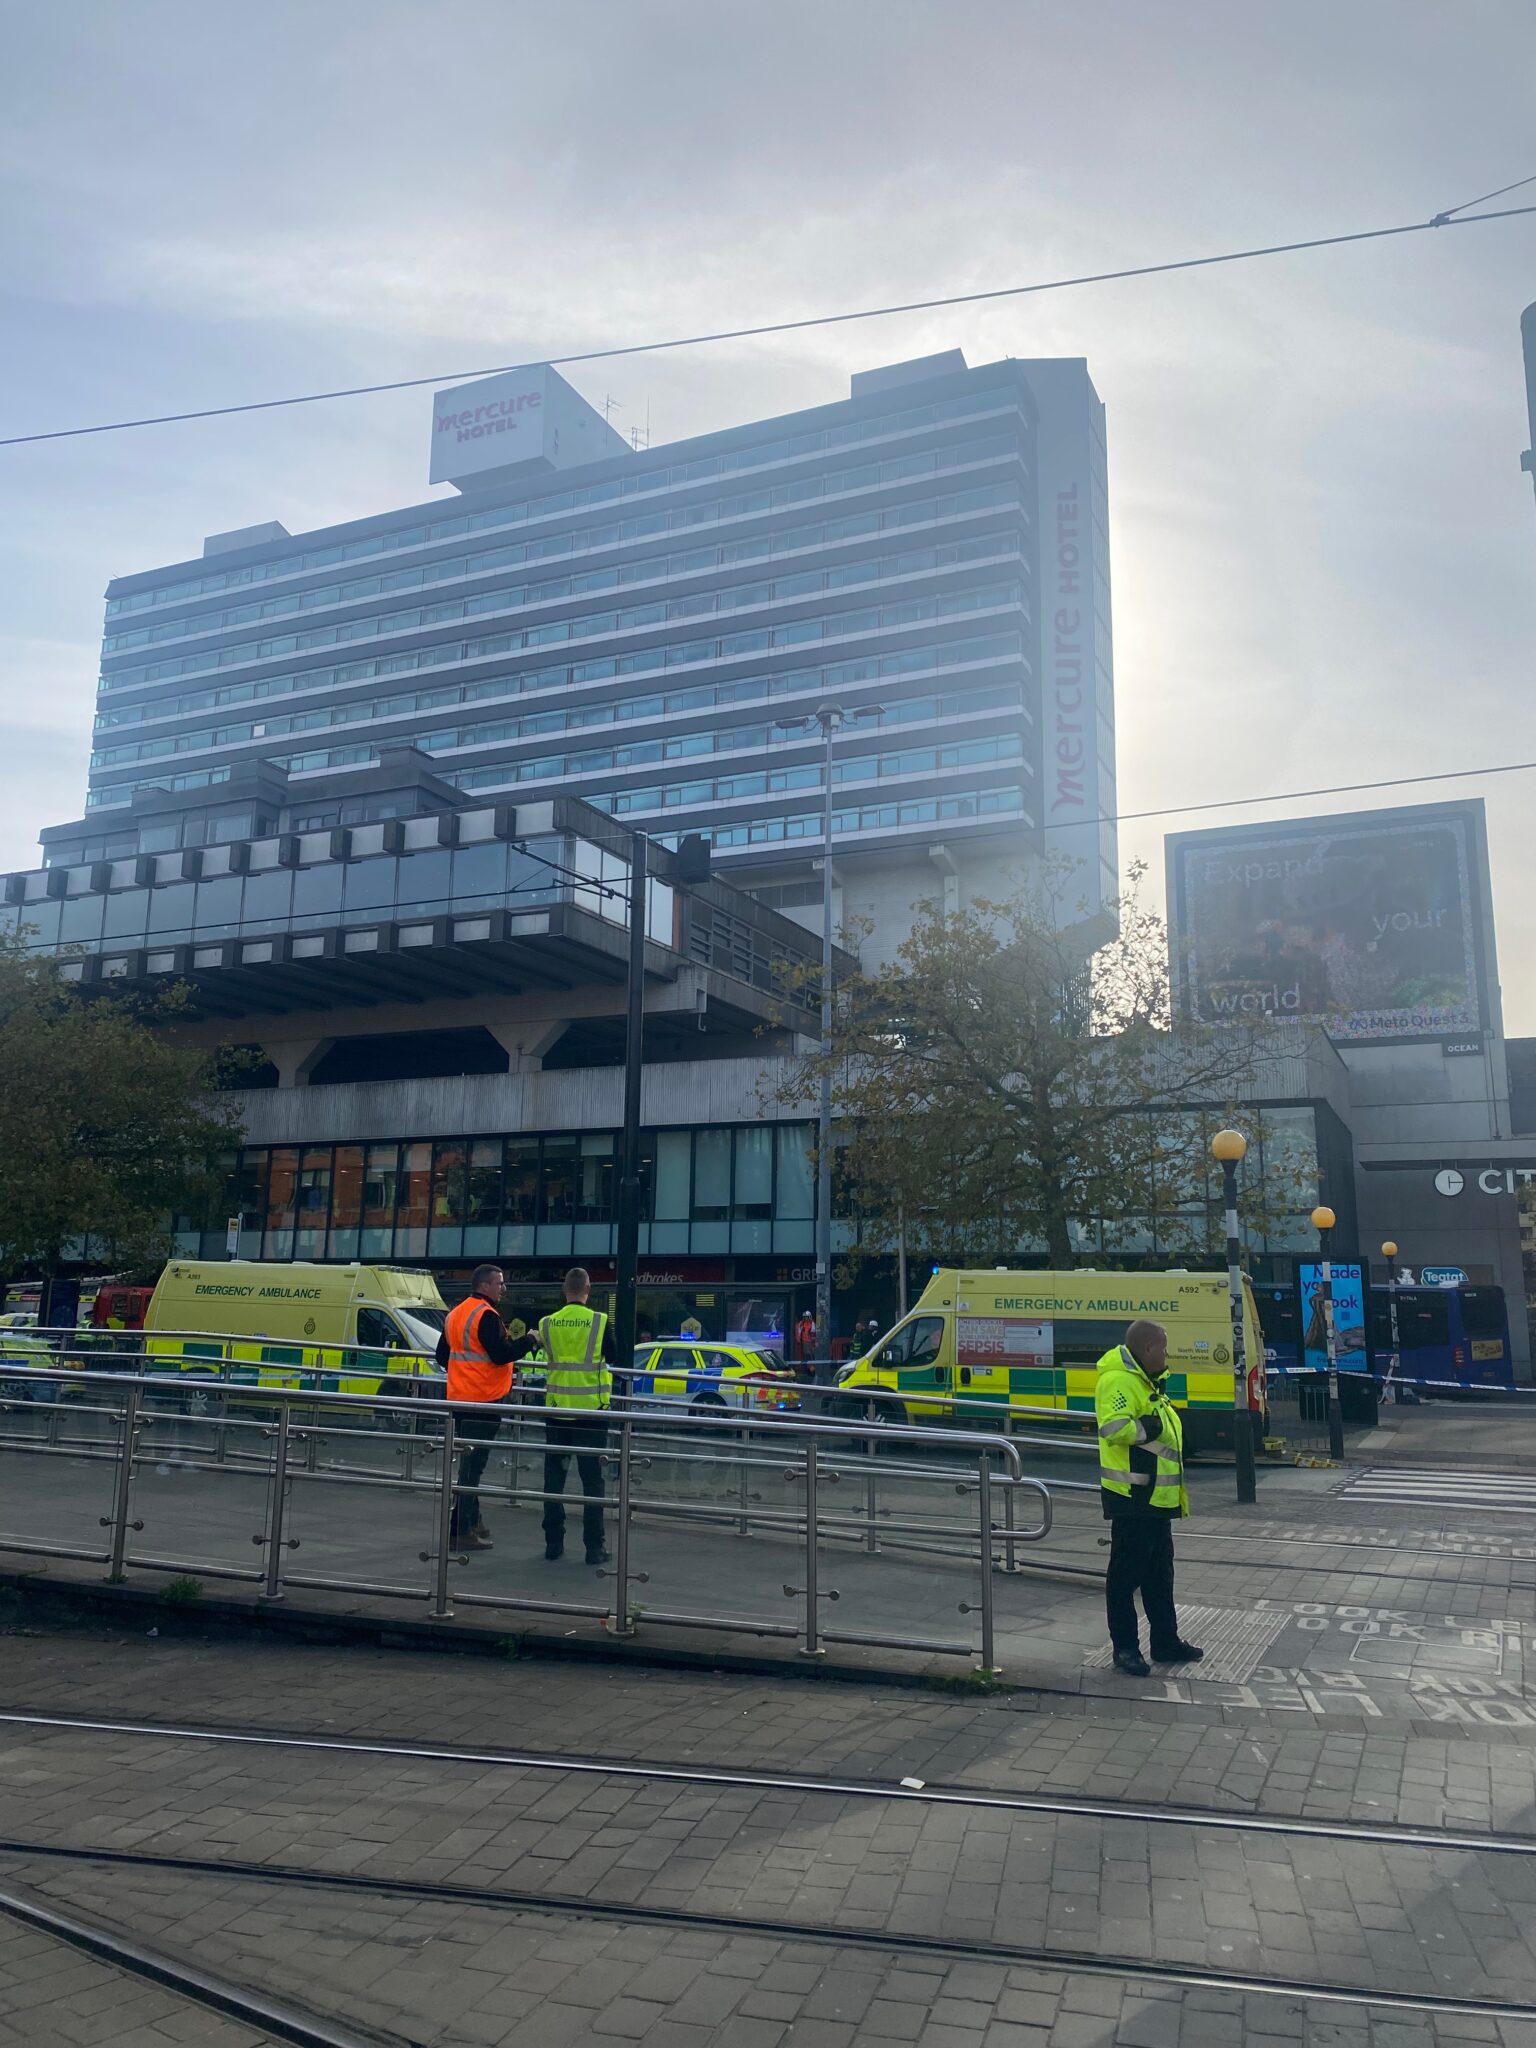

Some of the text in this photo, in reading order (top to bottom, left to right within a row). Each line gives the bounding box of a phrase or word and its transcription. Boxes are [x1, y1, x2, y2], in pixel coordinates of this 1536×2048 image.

[457, 417, 518, 443] HOTEL
[1056, 481, 1081, 594] HOTEL
[1205, 851, 1325, 888] Expand
[1371, 908, 1449, 940] your
[1209, 982, 1301, 1014] world
[1369, 1016, 1409, 1030] Meta
[1411, 1014, 1457, 1028] Quest
[1447, 1044, 1479, 1053] OCEAN
[195, 1284, 321, 1299] EMERGENCY AMBULANCE
[1178, 1286, 1199, 1294] A592
[994, 1298, 1179, 1312] EMERGENCY AMBULANCE
[1332, 1294, 1359, 1308] ook
[549, 1318, 591, 1328] Metrolink
[958, 1340, 1005, 1353] SEPSIS
[1254, 1599, 1410, 1623] LOOK
